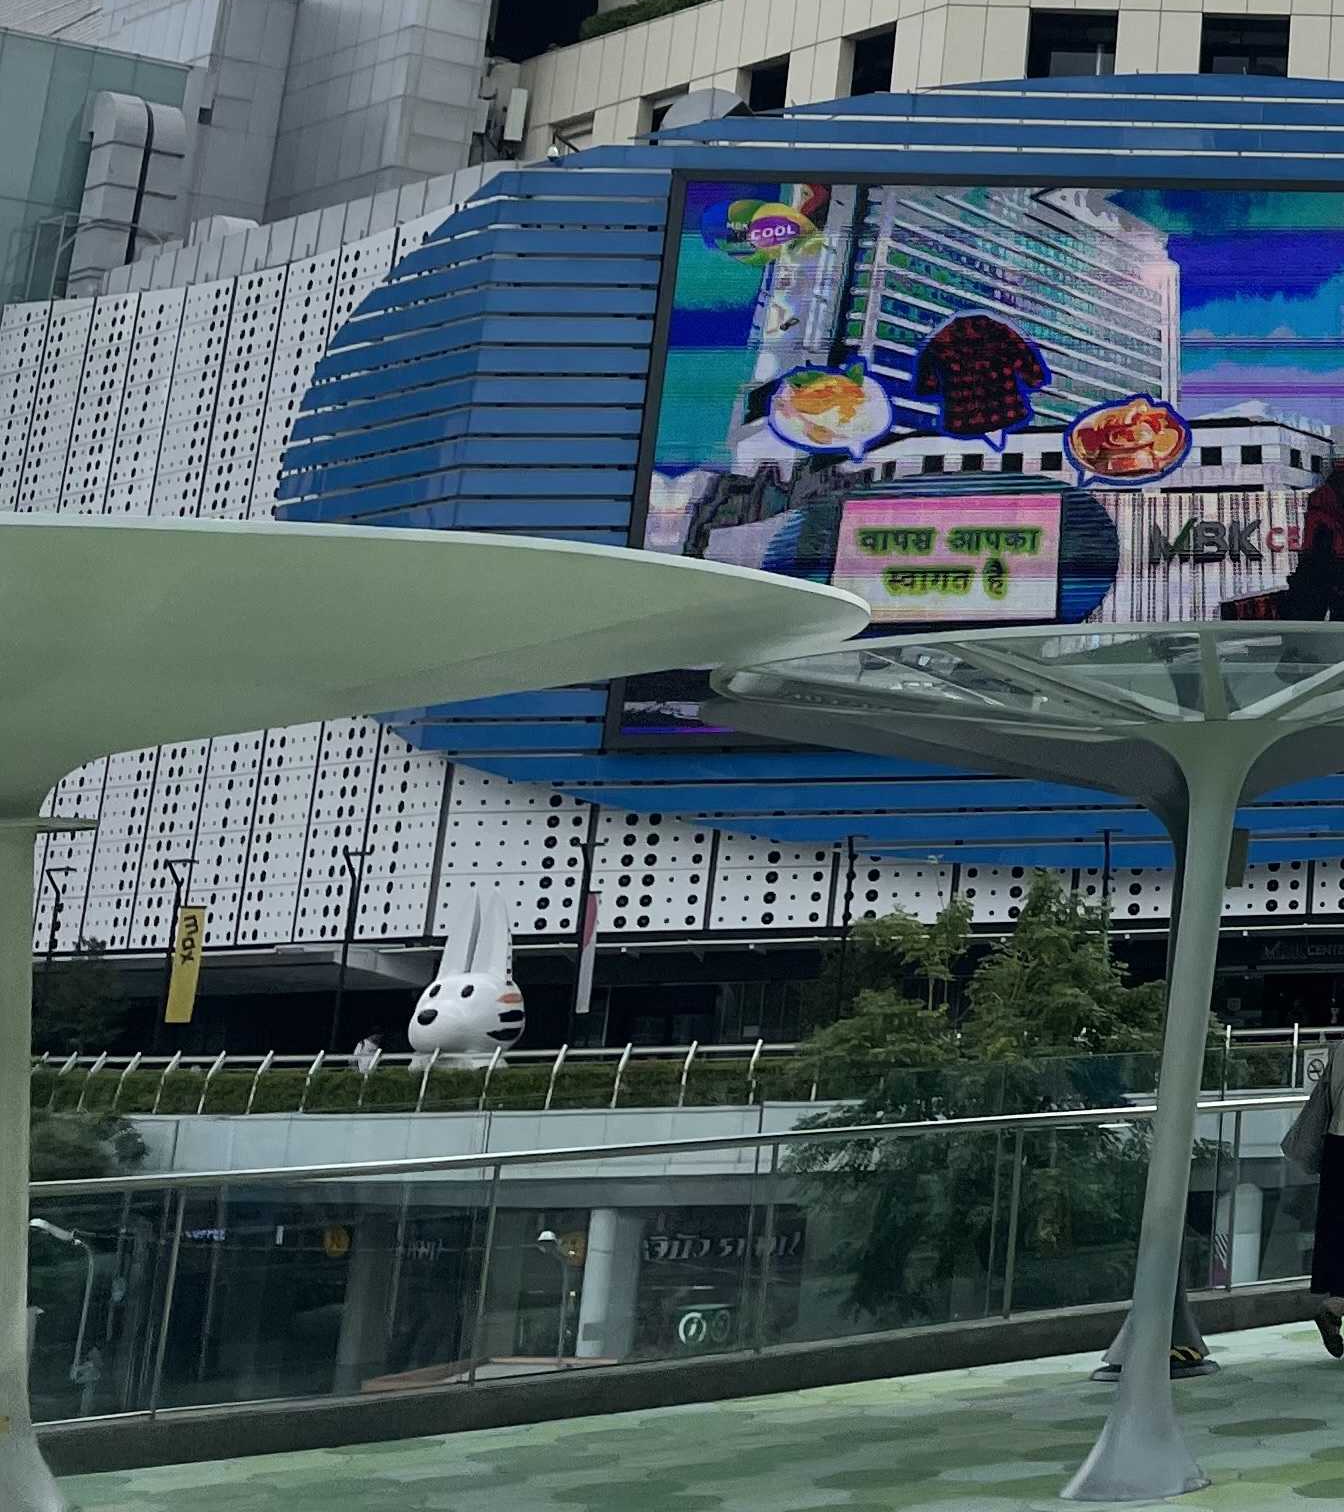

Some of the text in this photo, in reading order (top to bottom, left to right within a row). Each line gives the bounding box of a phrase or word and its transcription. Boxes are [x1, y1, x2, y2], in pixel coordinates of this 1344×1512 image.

[750, 224, 796, 241] COOL
[1149, 518, 1264, 564] MBK
[180, 913, 200, 966] max
